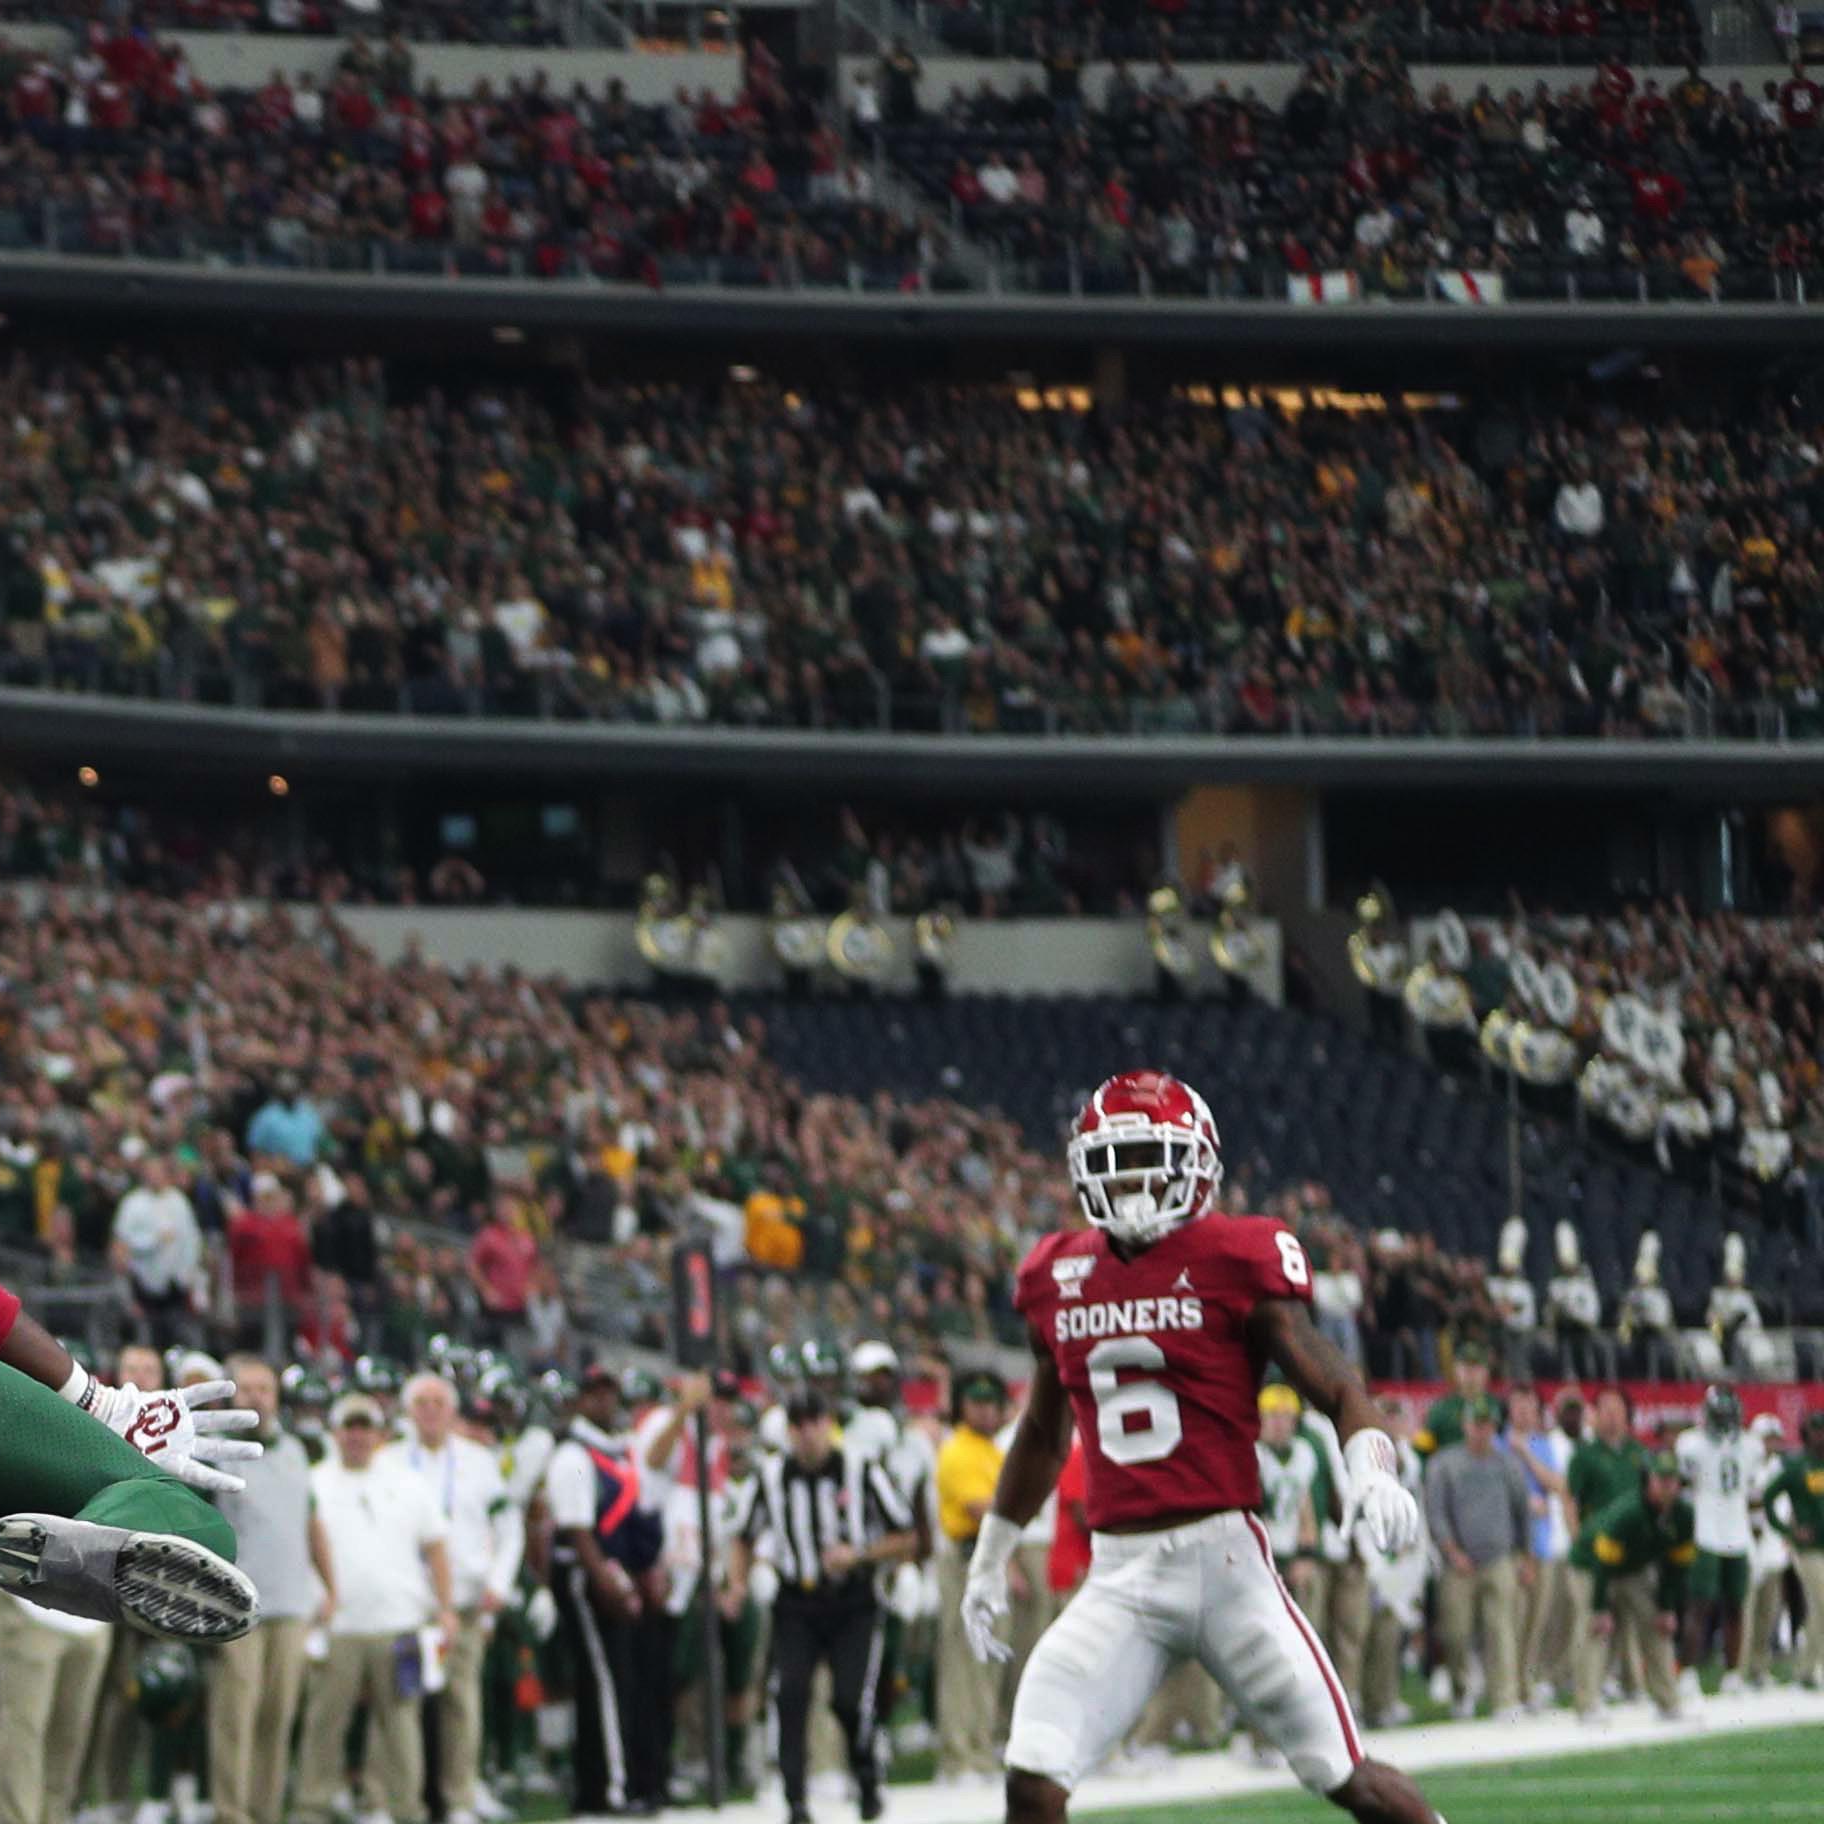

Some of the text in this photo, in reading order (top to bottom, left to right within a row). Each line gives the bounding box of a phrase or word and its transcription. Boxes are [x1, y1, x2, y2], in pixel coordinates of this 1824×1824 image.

[1274, 1230, 1308, 1286] 6
[1055, 1297, 1203, 1343] SOONERS
[1085, 1335, 1183, 1466] 6
